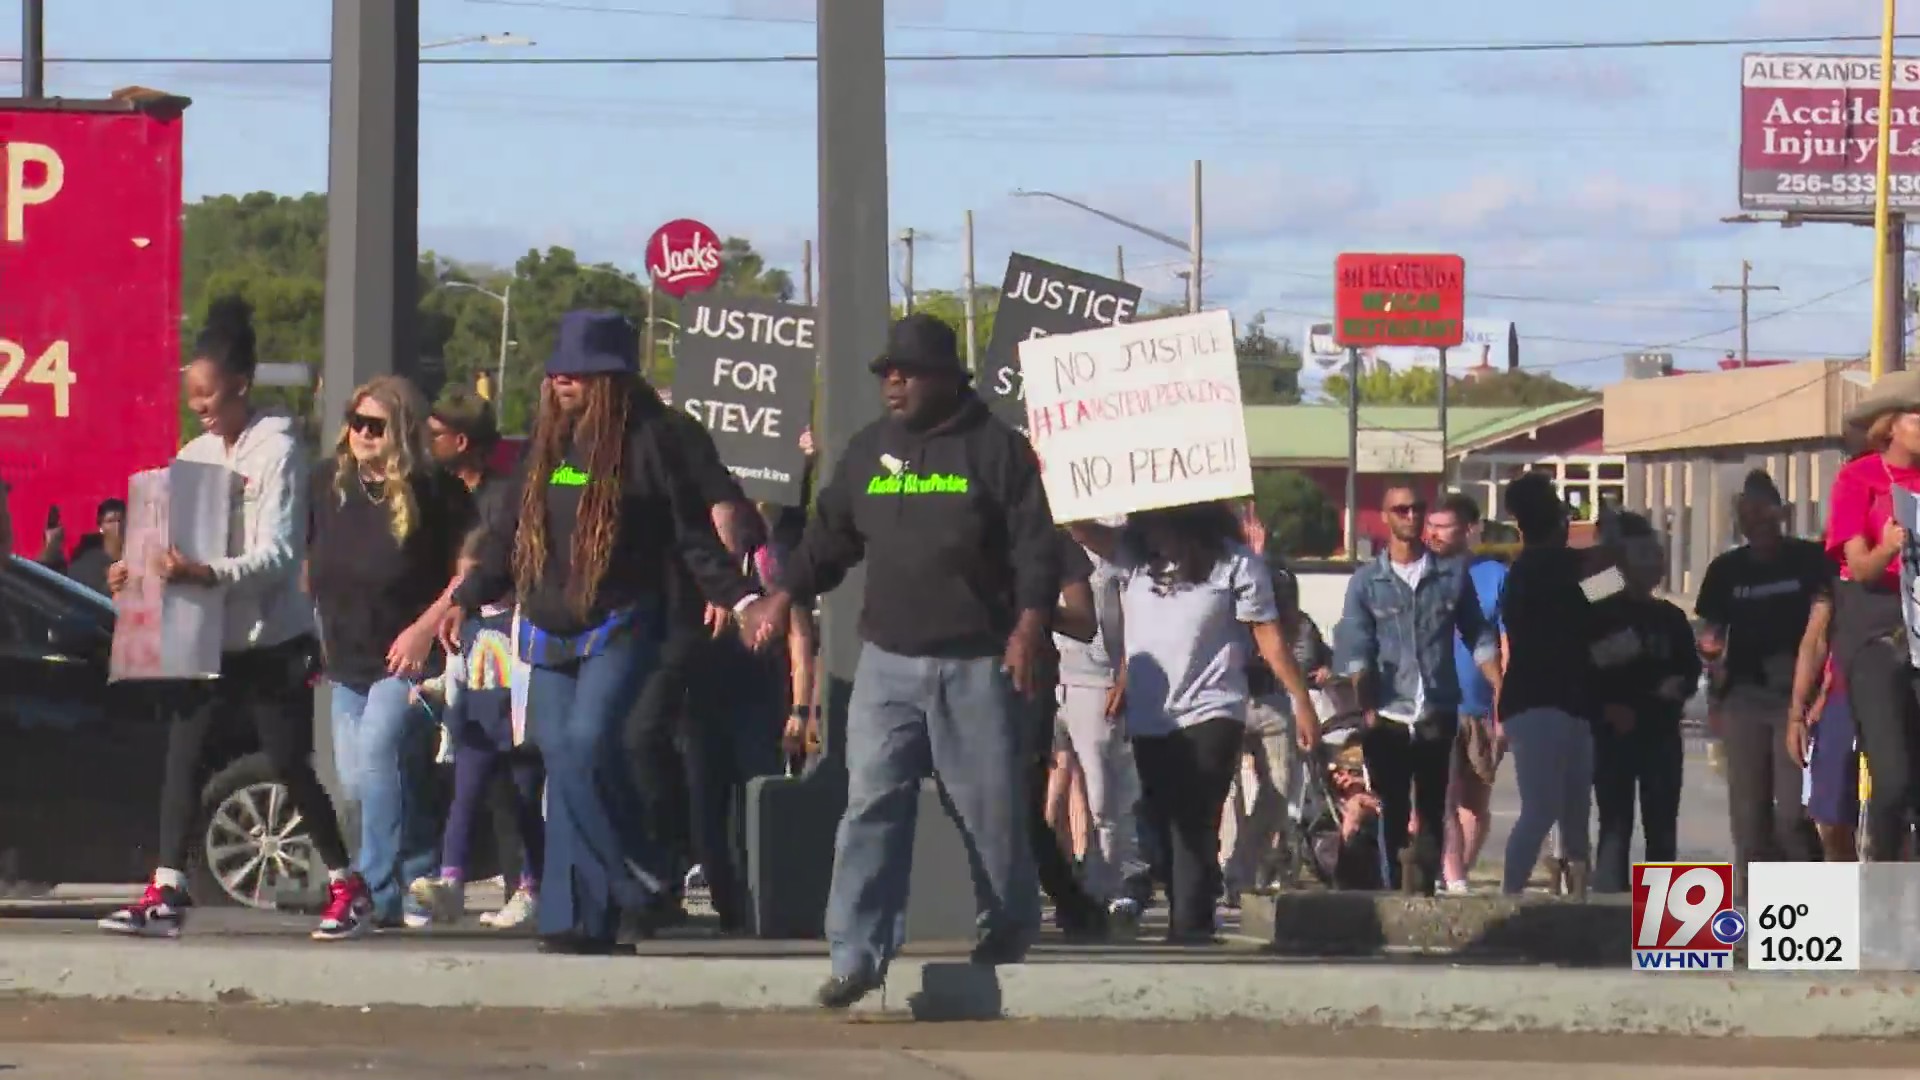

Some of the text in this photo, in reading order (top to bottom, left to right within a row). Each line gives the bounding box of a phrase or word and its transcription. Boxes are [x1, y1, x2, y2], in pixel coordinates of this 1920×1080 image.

[1750, 62, 1896, 81] ALEXANDE
[1763, 97, 1920, 126] Accident
[1762, 127, 1878, 163] Injury
[1776, 173, 1920, 193] 256-533130
[653, 232, 718, 279] Jack's
[1369, 262, 1458, 288] HACIENDA
[1007, 271, 1135, 326] JUSTICE
[688, 306, 815, 349] JUSTICE
[713, 357, 777, 393] FOR
[1054, 350, 1096, 393] NO
[1112, 328, 1225, 372] JUSTICE
[685, 398, 782, 437] STEVE
[1070, 438, 1237, 498] NO PEACE!!
